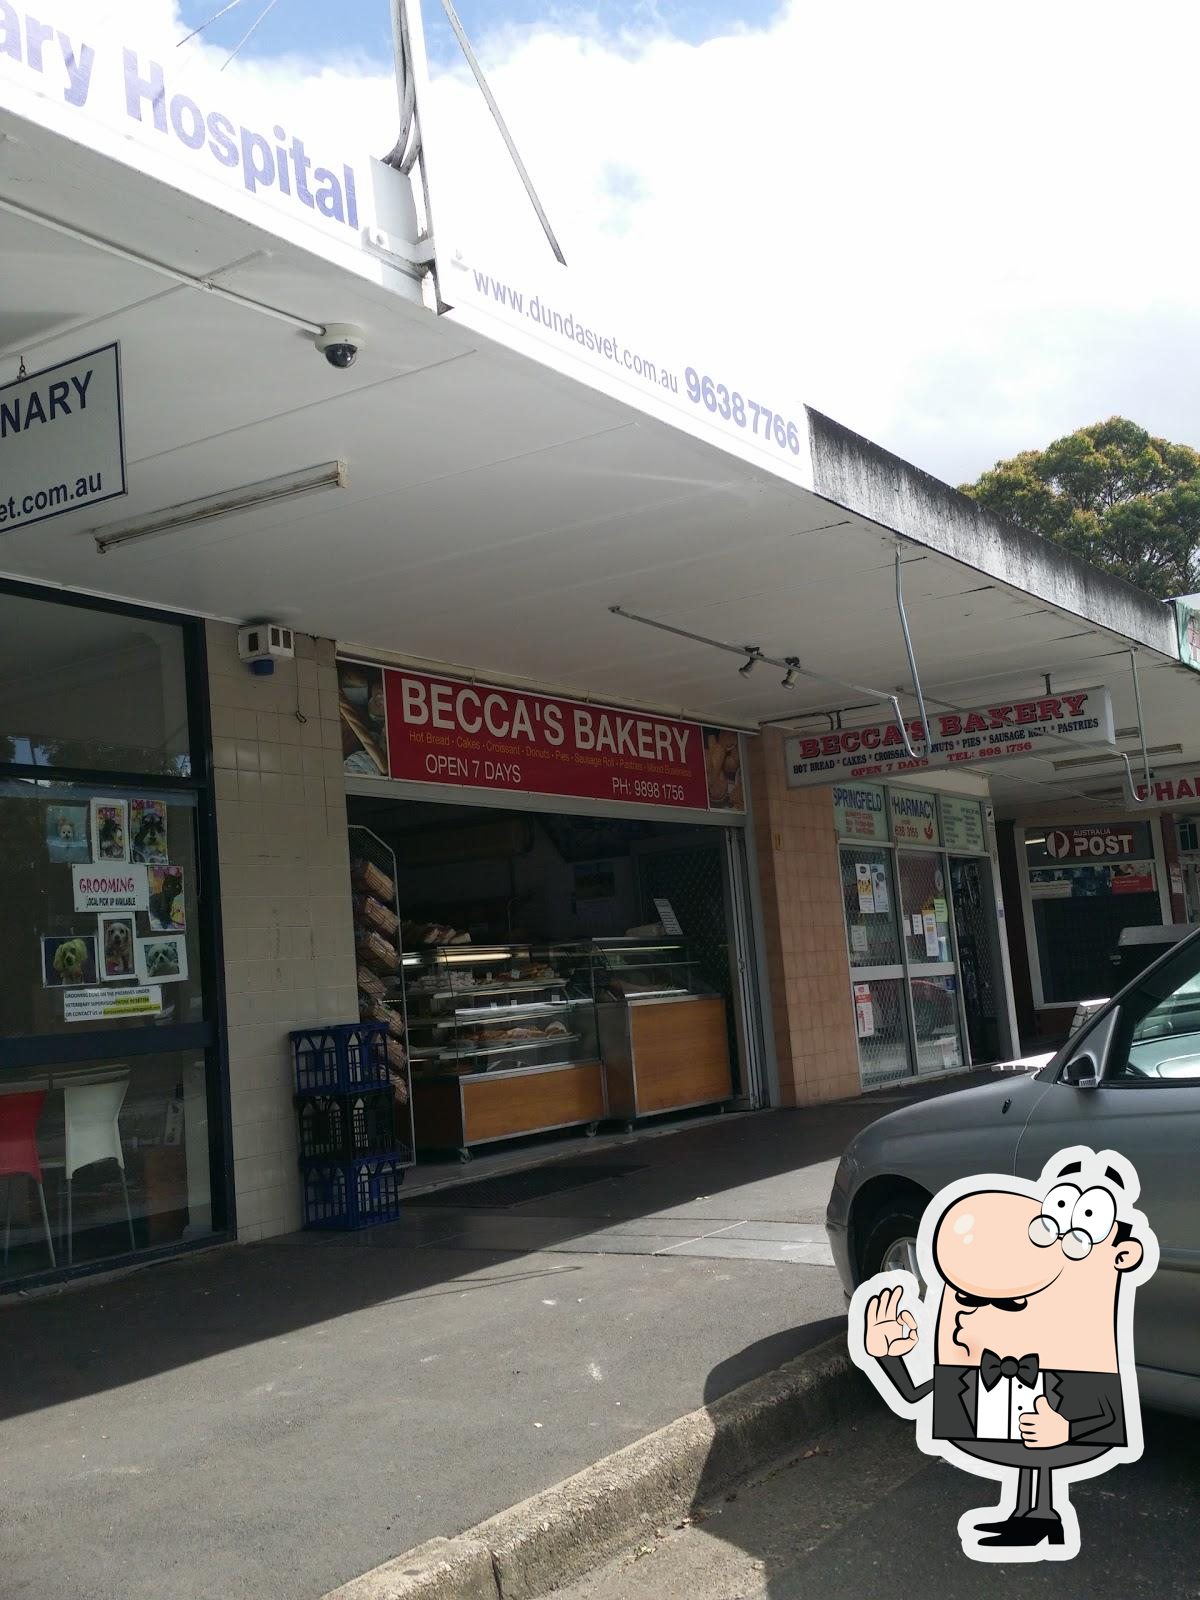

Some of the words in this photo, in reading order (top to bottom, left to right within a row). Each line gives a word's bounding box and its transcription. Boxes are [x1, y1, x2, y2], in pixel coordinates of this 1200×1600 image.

[122, 45, 359, 230] Hospital
[473, 268, 679, 394] www.dundasvet.com.au
[0, 370, 93, 438] NARY
[0, 472, 102, 523] et.com.au
[401, 678, 565, 746] BECCA'S
[574, 709, 690, 764] BAKERY
[799, 720, 929, 759] BECCA'S
[938, 693, 1089, 737] BAKERY
[409, 730, 424, 743] Hot
[427, 732, 450, 747] Bread
[456, 736, 480, 750] Cakes
[486, 741, 521, 756] Croissant
[526, 746, 551, 760] Donuts
[793, 764, 807, 774] HOT
[810, 760, 835, 771] BREAD
[842, 754, 867, 766] CAKES
[962, 737, 981, 748] PIES
[989, 730, 1025, 744] SAUSAGE
[1057, 718, 1099, 734] PASTRIES
[851, 763, 884, 777] OPEN
[887, 763, 894, 771] 7
[898, 759, 929, 770] DAYS
[947, 752, 975, 762] TEL:
[978, 746, 1001, 757] 898
[1006, 742, 1033, 754] 1756
[425, 753, 469, 777] OPEN
[472, 760, 480, 778] 7
[485, 761, 522, 783] DAYS
[612, 776, 631, 796] PH:
[634, 778, 659, 798] 9898
[662, 783, 685, 801] 1756
[832, 787, 882, 812] SPRINGFIELD
[1073, 827, 1111, 837] AUSTRALIA
[1074, 834, 1133, 856] POST
[80, 878, 135, 893] GROOMING
